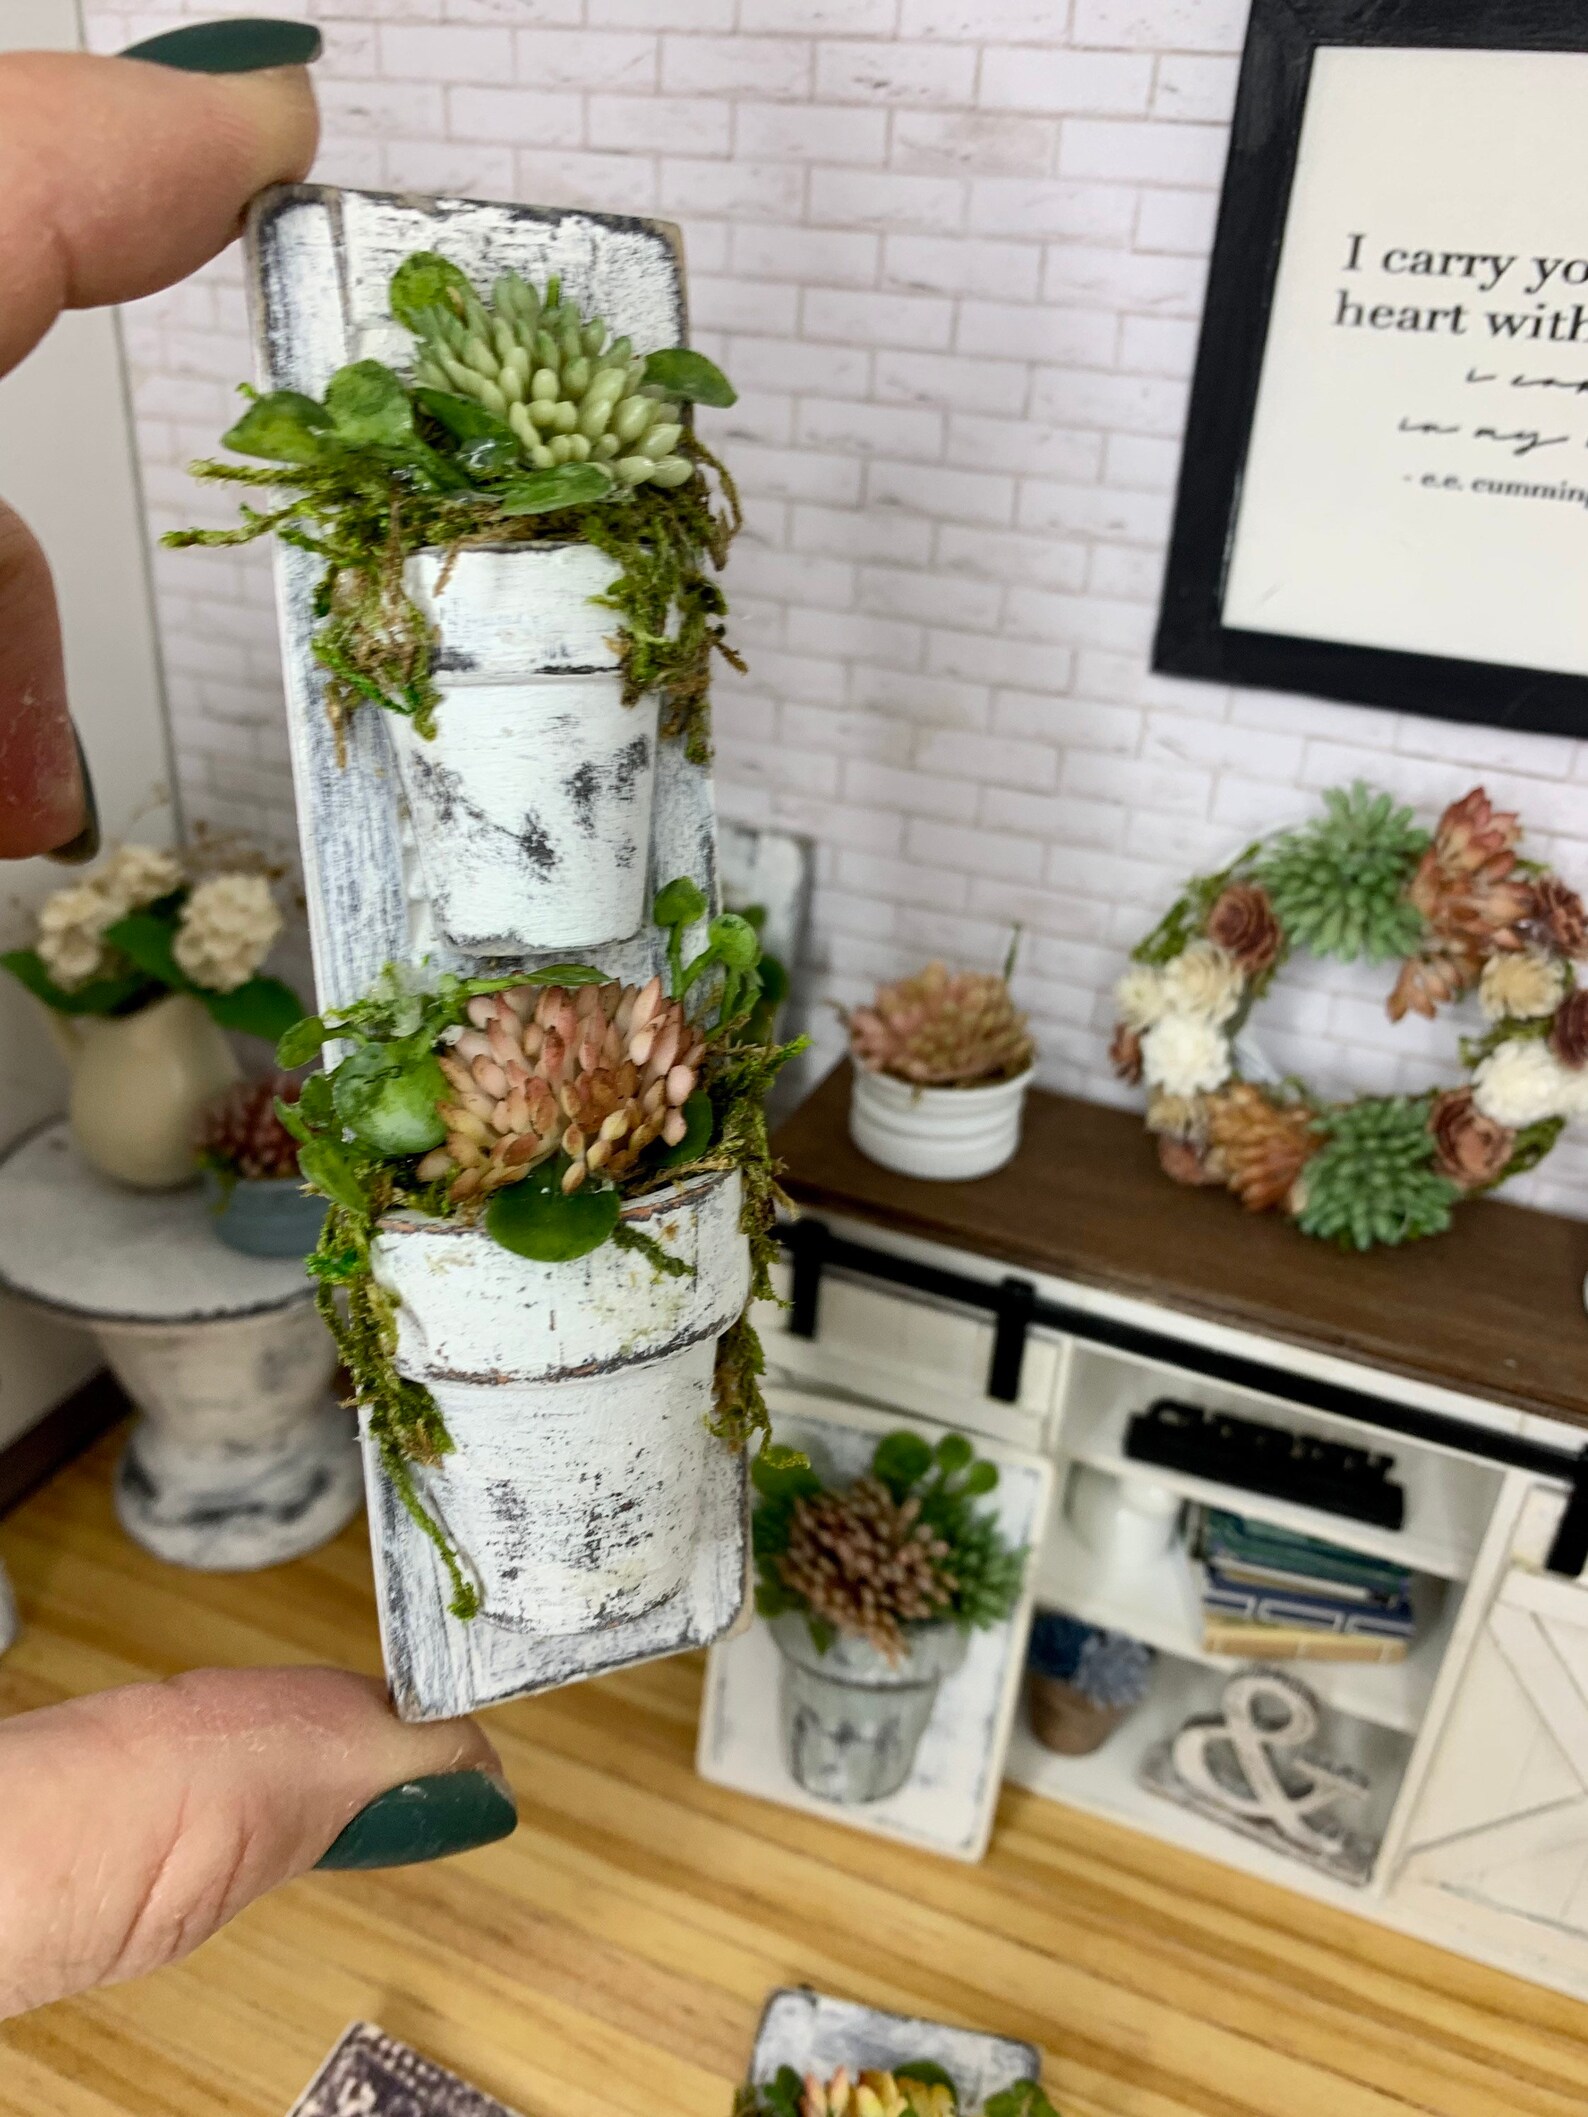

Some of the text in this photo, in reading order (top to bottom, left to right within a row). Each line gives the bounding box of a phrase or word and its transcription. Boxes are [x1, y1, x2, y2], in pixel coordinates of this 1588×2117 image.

[1342, 233, 1588, 295] I carry yo
[1333, 288, 1588, 343] heart with
[1470, 478, 1588, 510] cummin
